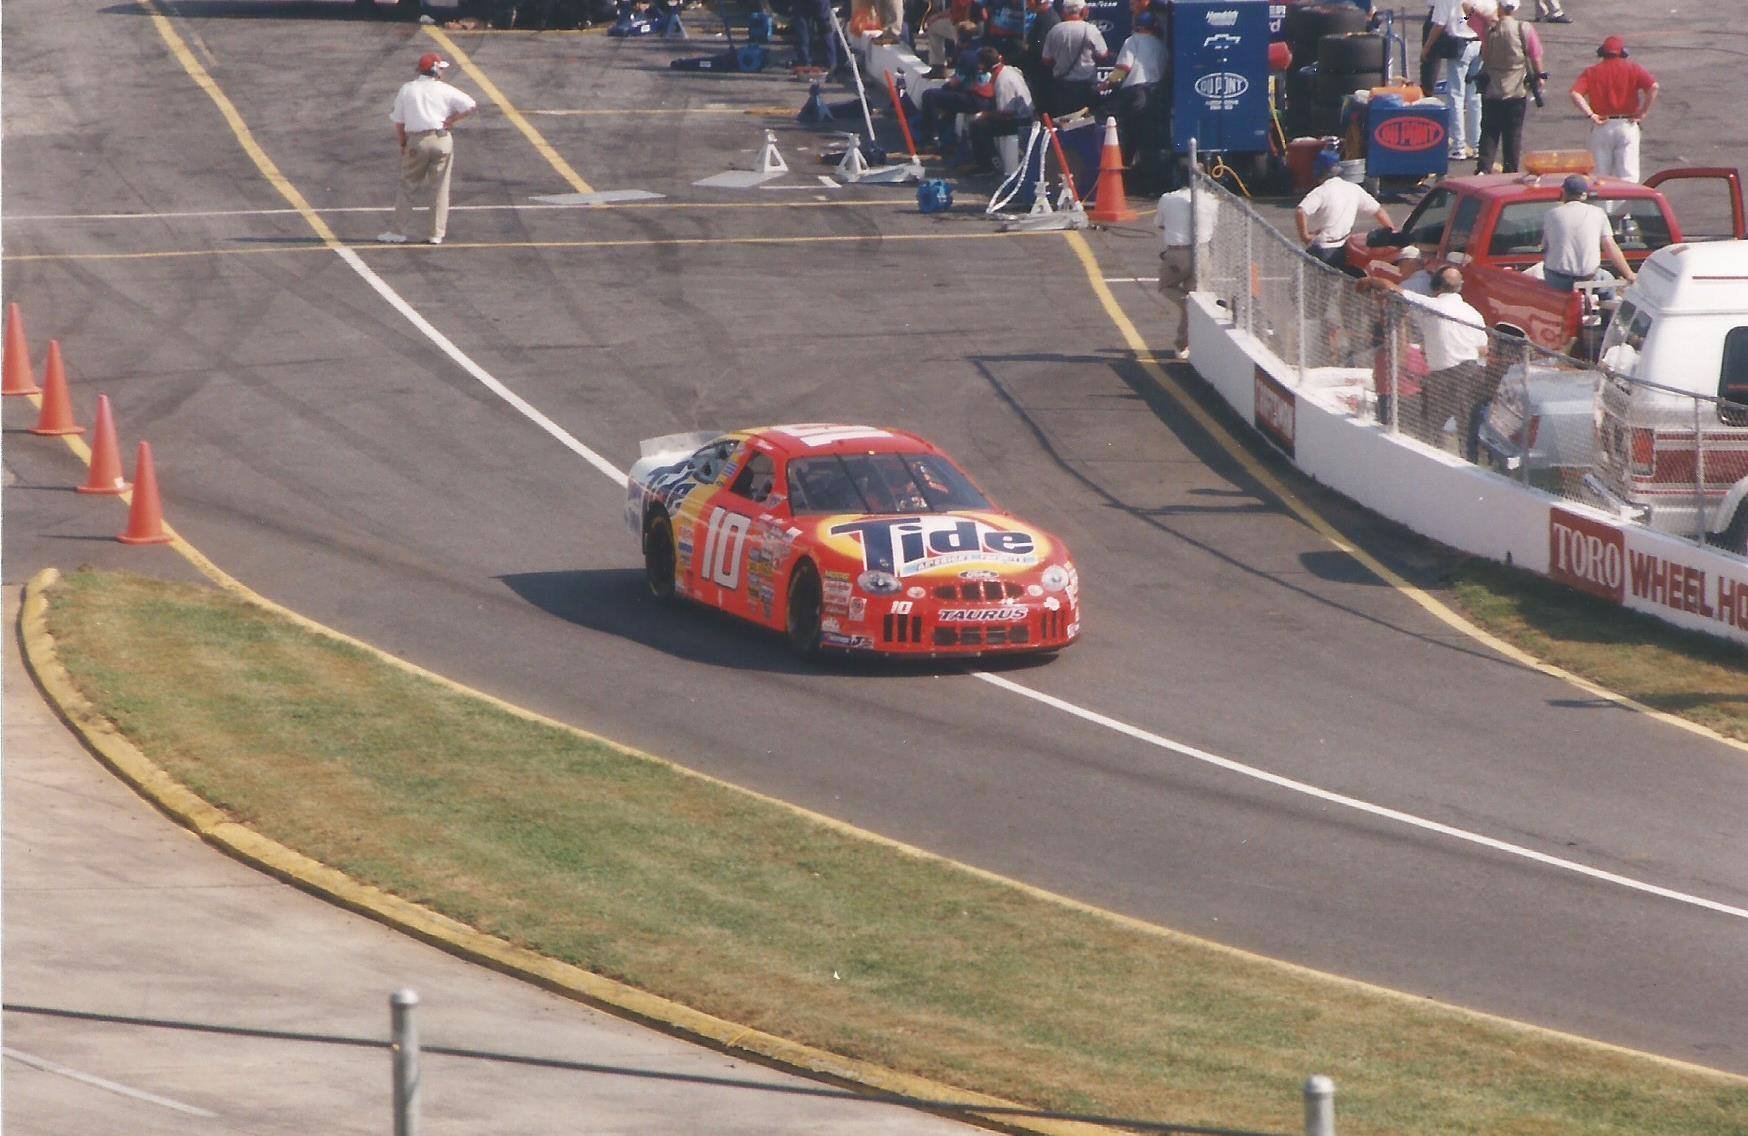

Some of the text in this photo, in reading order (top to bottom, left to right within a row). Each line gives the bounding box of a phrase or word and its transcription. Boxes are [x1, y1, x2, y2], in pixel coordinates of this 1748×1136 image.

[701, 506, 751, 589] 10
[829, 517, 1035, 577] Tide
[1553, 523, 1622, 588] TORO
[1629, 549, 1714, 618] WHEEL
[891, 601, 913, 614] 10
[939, 605, 1028, 622] TAURUS
